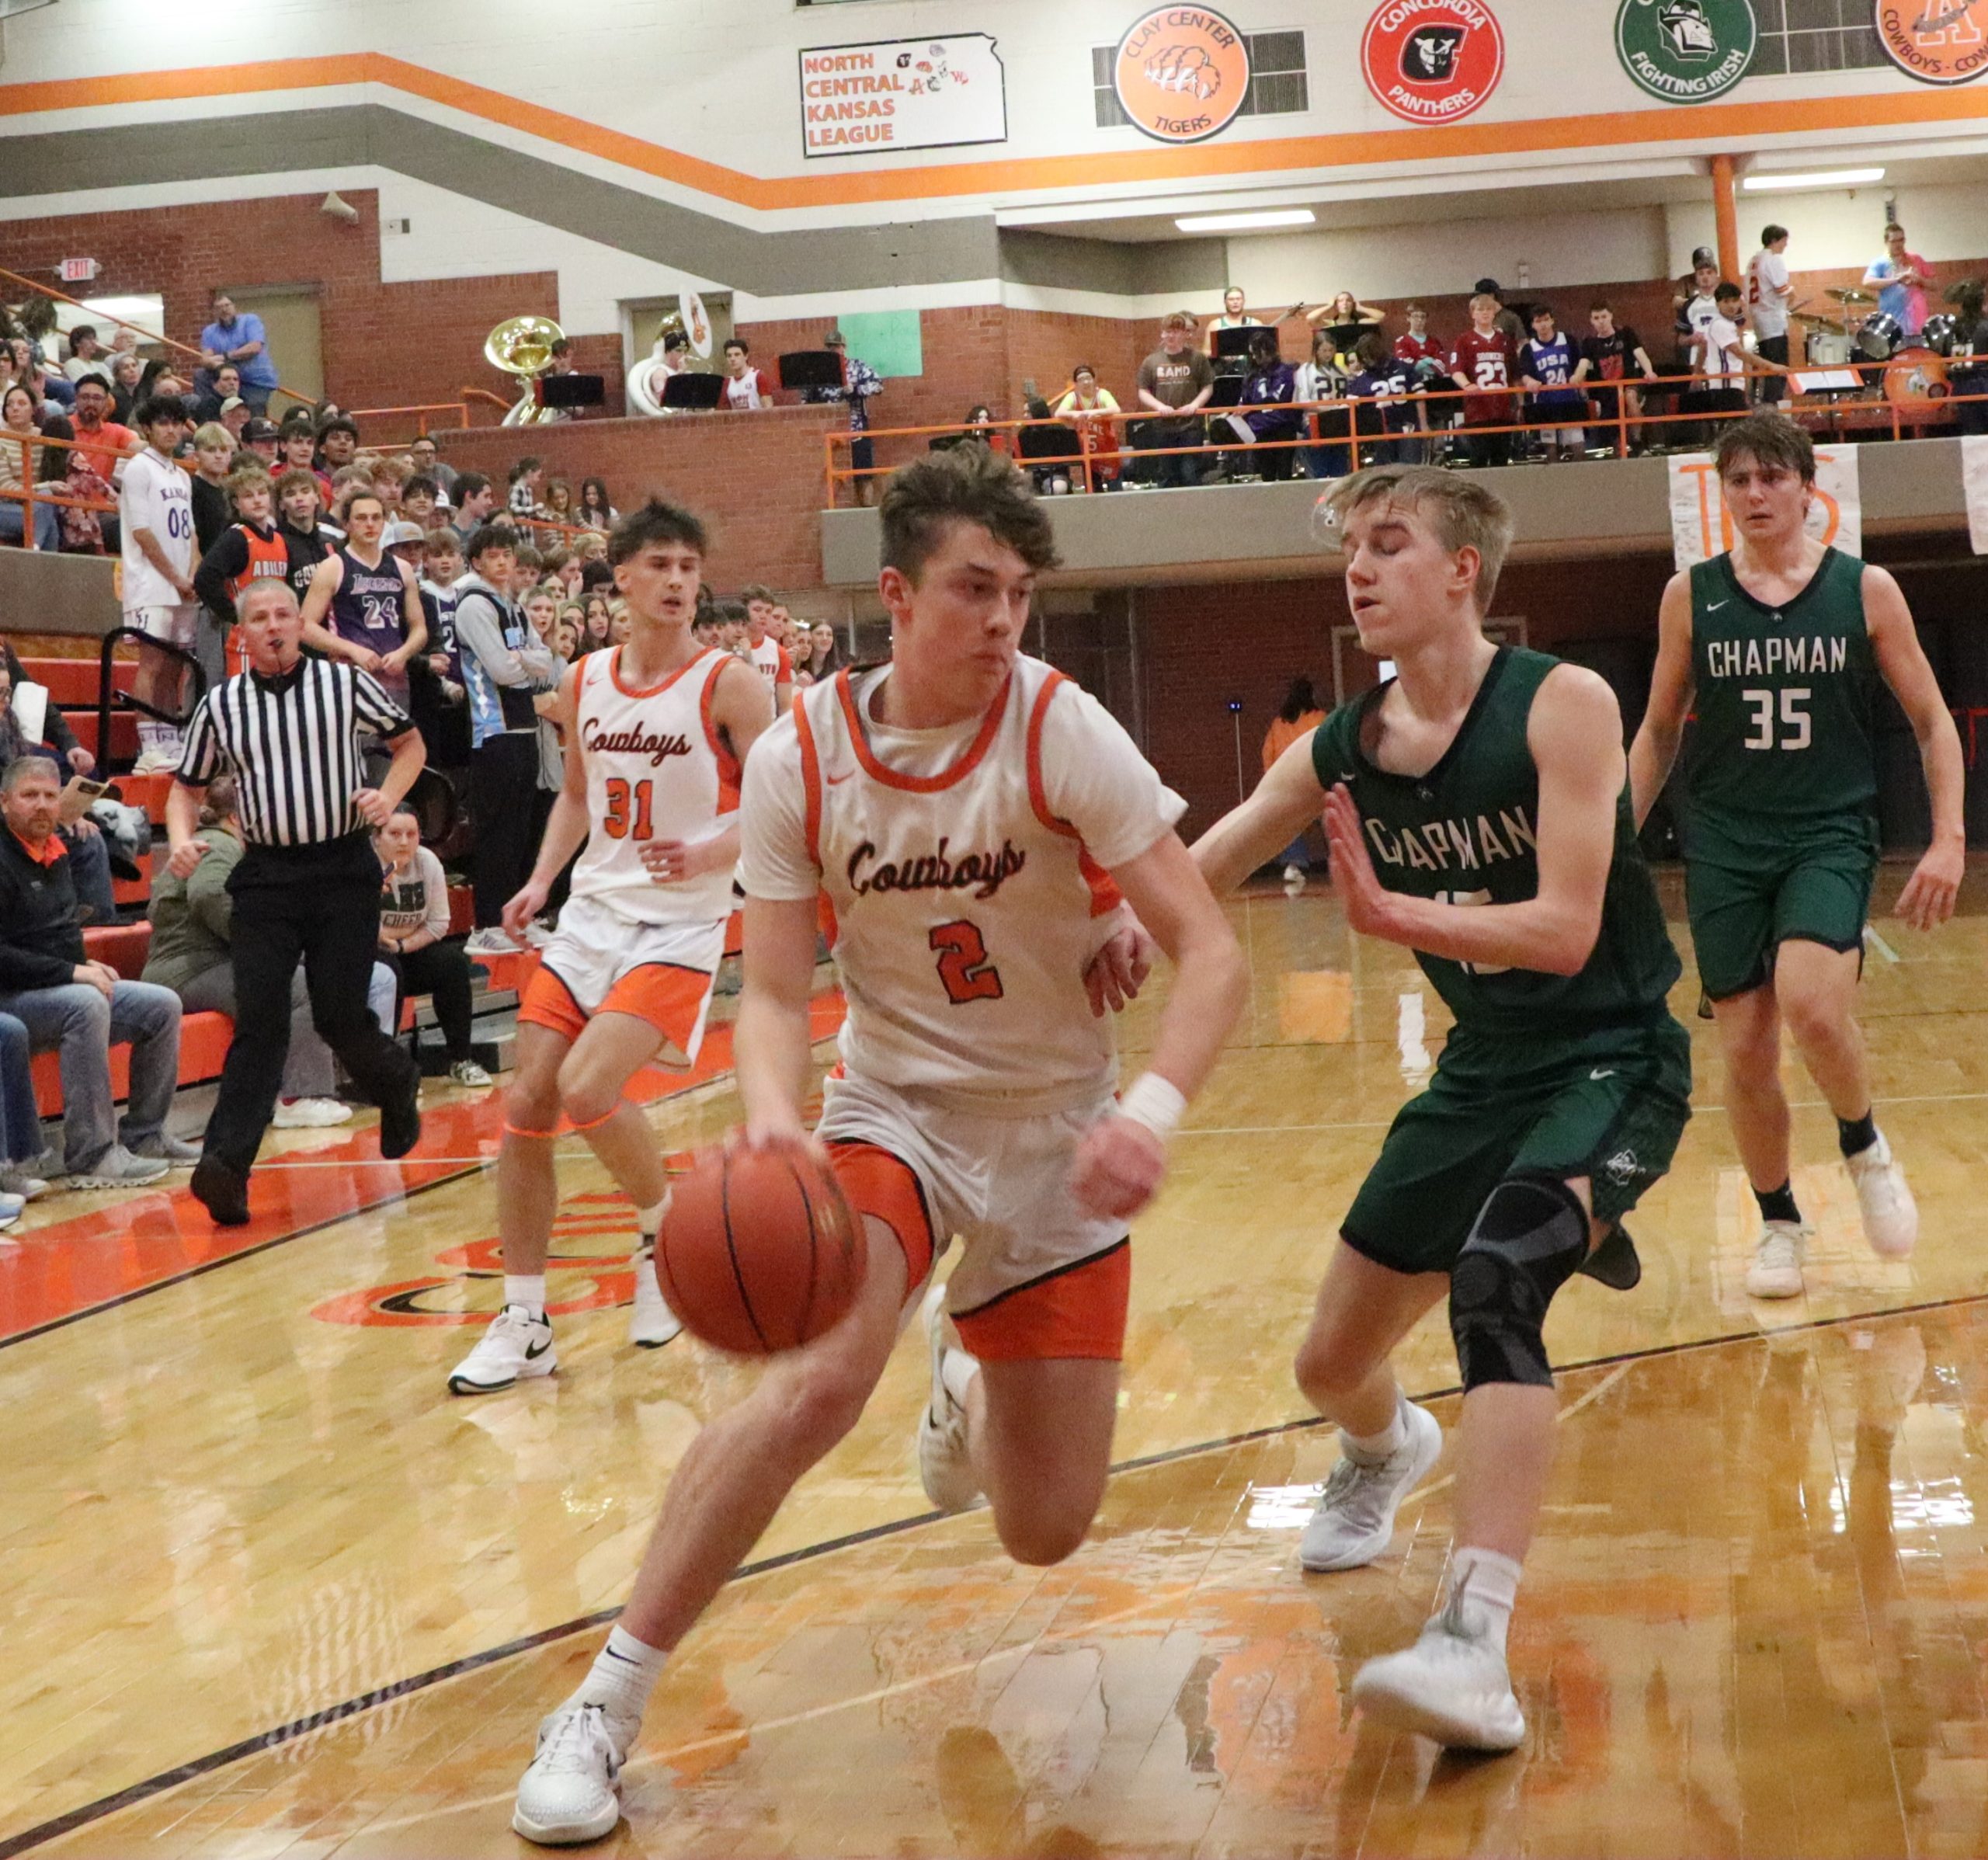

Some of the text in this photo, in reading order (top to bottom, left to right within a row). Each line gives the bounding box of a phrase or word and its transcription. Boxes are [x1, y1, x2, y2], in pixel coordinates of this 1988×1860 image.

[1126, 12, 1235, 58] CLAY CENTER
[1884, 9, 1942, 73] COWBOYS
[805, 53, 874, 74] NORTH
[1631, 48, 1746, 93] FIGHTING IRISH
[805, 74, 905, 98] CENTRAL
[1388, 85, 1475, 114] PANTHERS
[807, 99, 895, 123] KANSAS
[1155, 113, 1211, 133] TIGERS
[808, 123, 894, 147] LEAGUE
[68, 260, 88, 279] EXIT
[1475, 361, 1508, 390] 23
[1536, 353, 1569, 371] USA
[1371, 375, 1407, 409] 25
[168, 507, 191, 540] 08
[362, 595, 399, 629] 24
[1708, 636, 1847, 677] CHAPMAN
[1742, 688, 1812, 750] 35
[583, 717, 692, 767] Cowboys
[604, 778, 653, 840] 31
[847, 836, 1026, 899] Cowboys
[928, 919, 1004, 1004] 2
